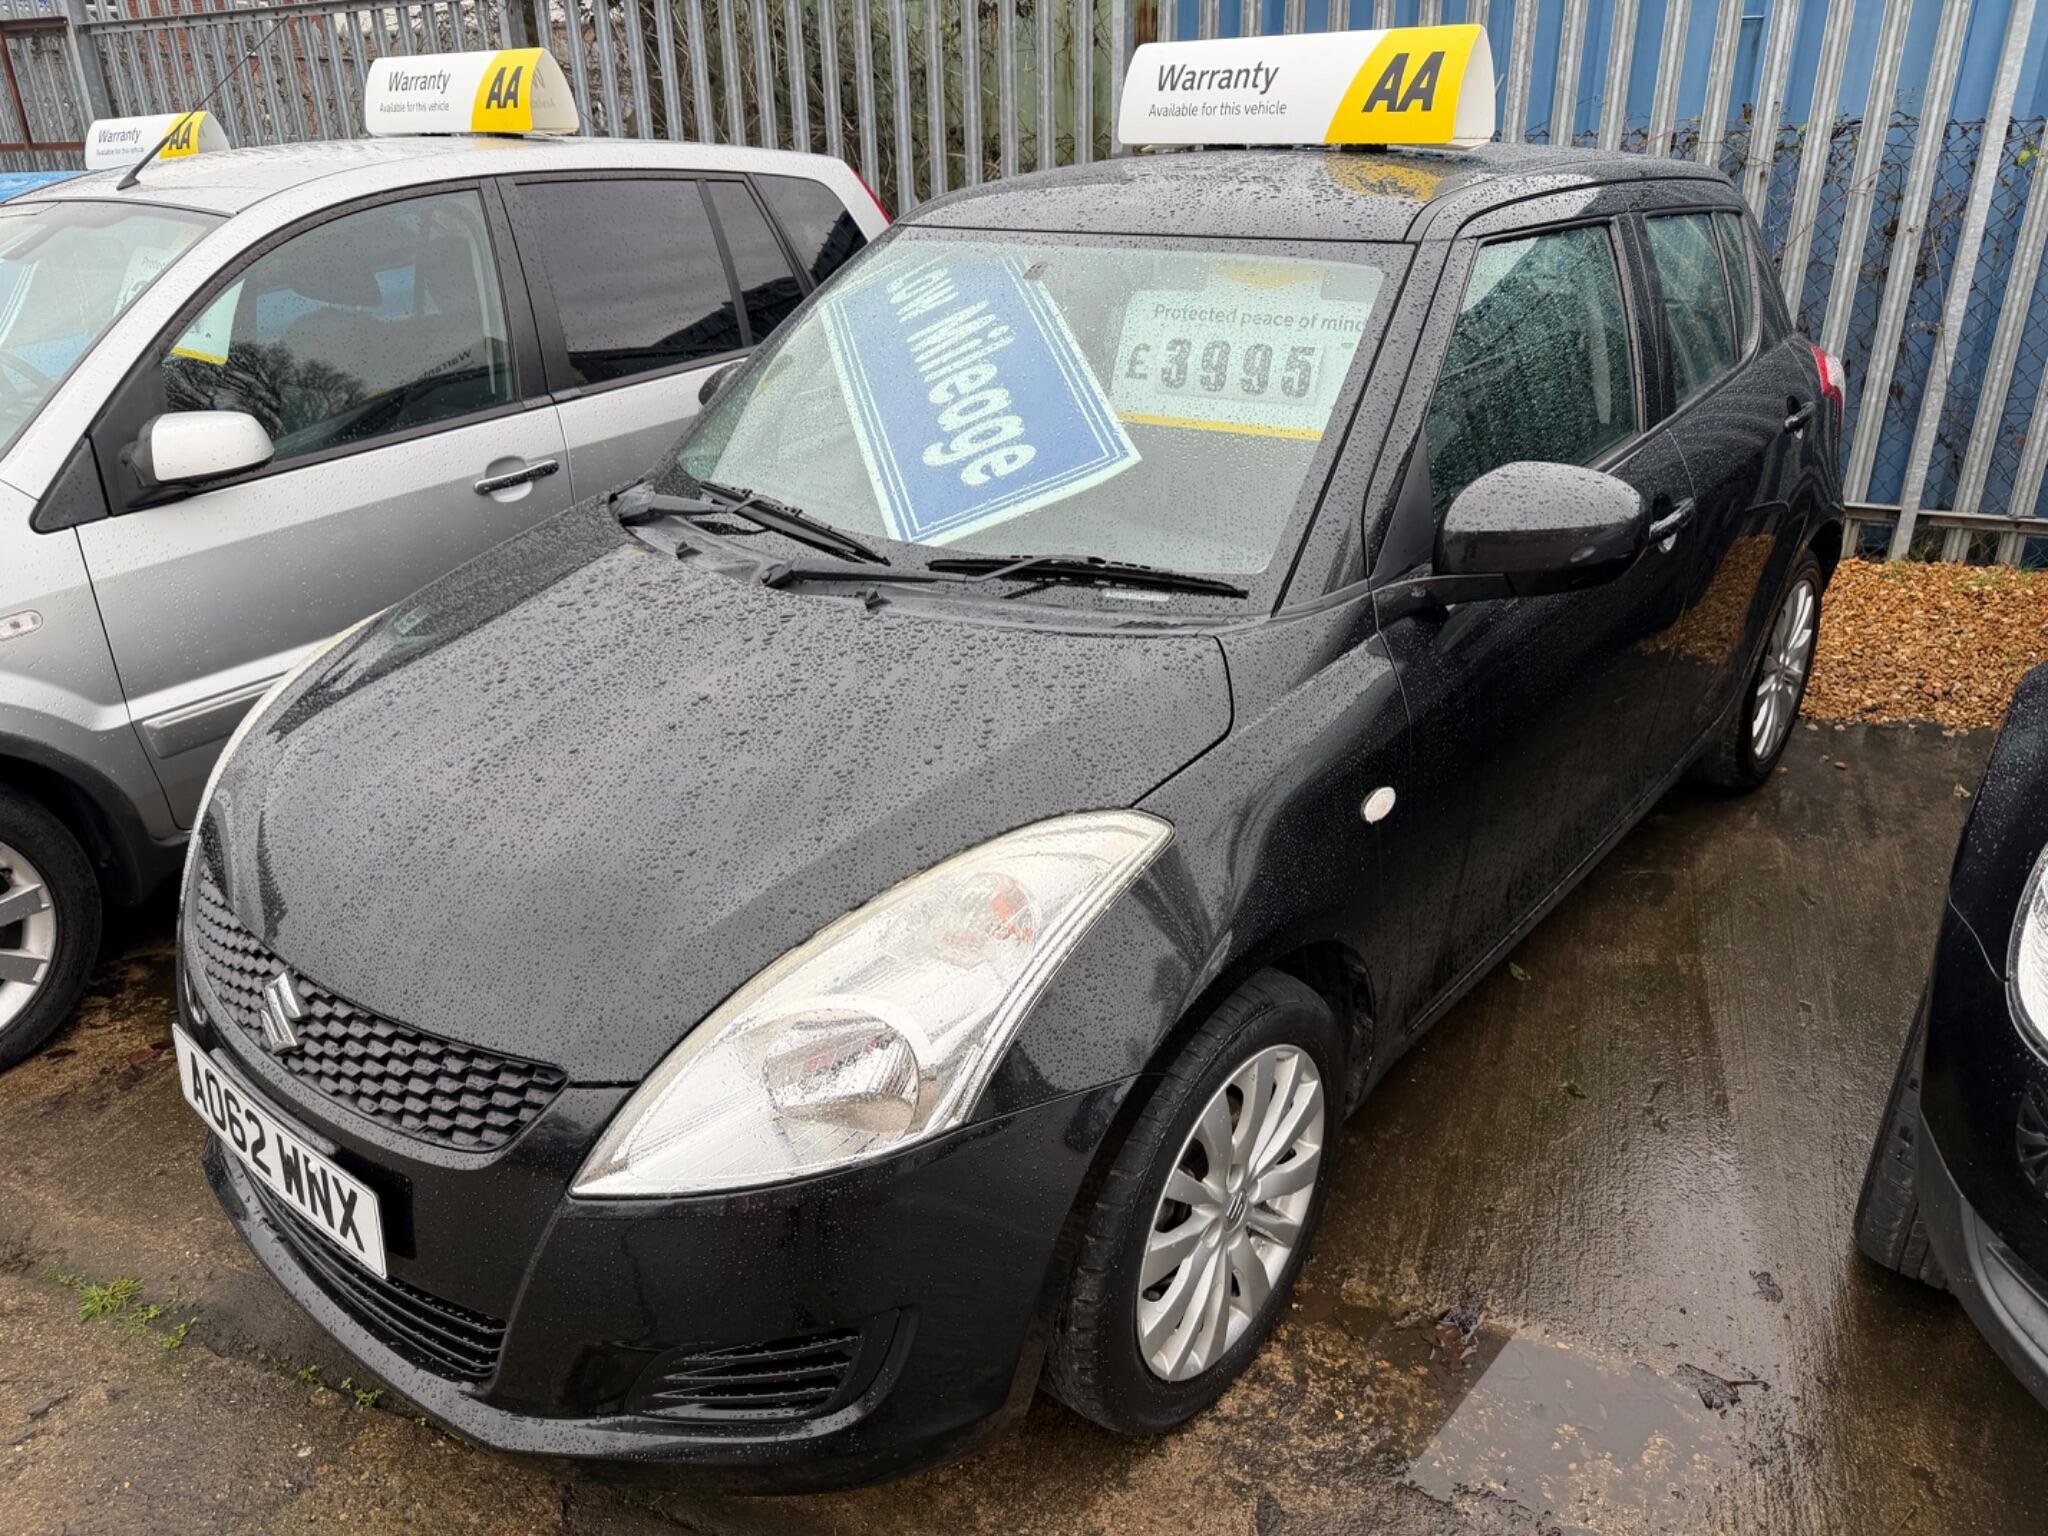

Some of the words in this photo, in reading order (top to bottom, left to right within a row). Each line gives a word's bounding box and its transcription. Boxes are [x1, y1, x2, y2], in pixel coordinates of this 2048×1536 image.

[389, 69, 451, 94] Warranty
[486, 66, 522, 109] AA
[1158, 61, 1280, 95] Warranty
[1361, 51, 1445, 113] AA
[1148, 103, 1198, 117] Available
[1201, 102, 1218, 116] for
[1219, 101, 1241, 116] this
[1244, 100, 1287, 115] vehicle
[99, 127, 141, 144] Warranty
[168, 122, 192, 150] AA
[1154, 303, 1237, 323] Protected
[1240, 312, 1294, 327] peace
[1299, 312, 1318, 329] of
[907, 300, 1036, 486] Mileage
[191, 1051, 271, 1177] AO62
[276, 1133, 365, 1253] WNX
